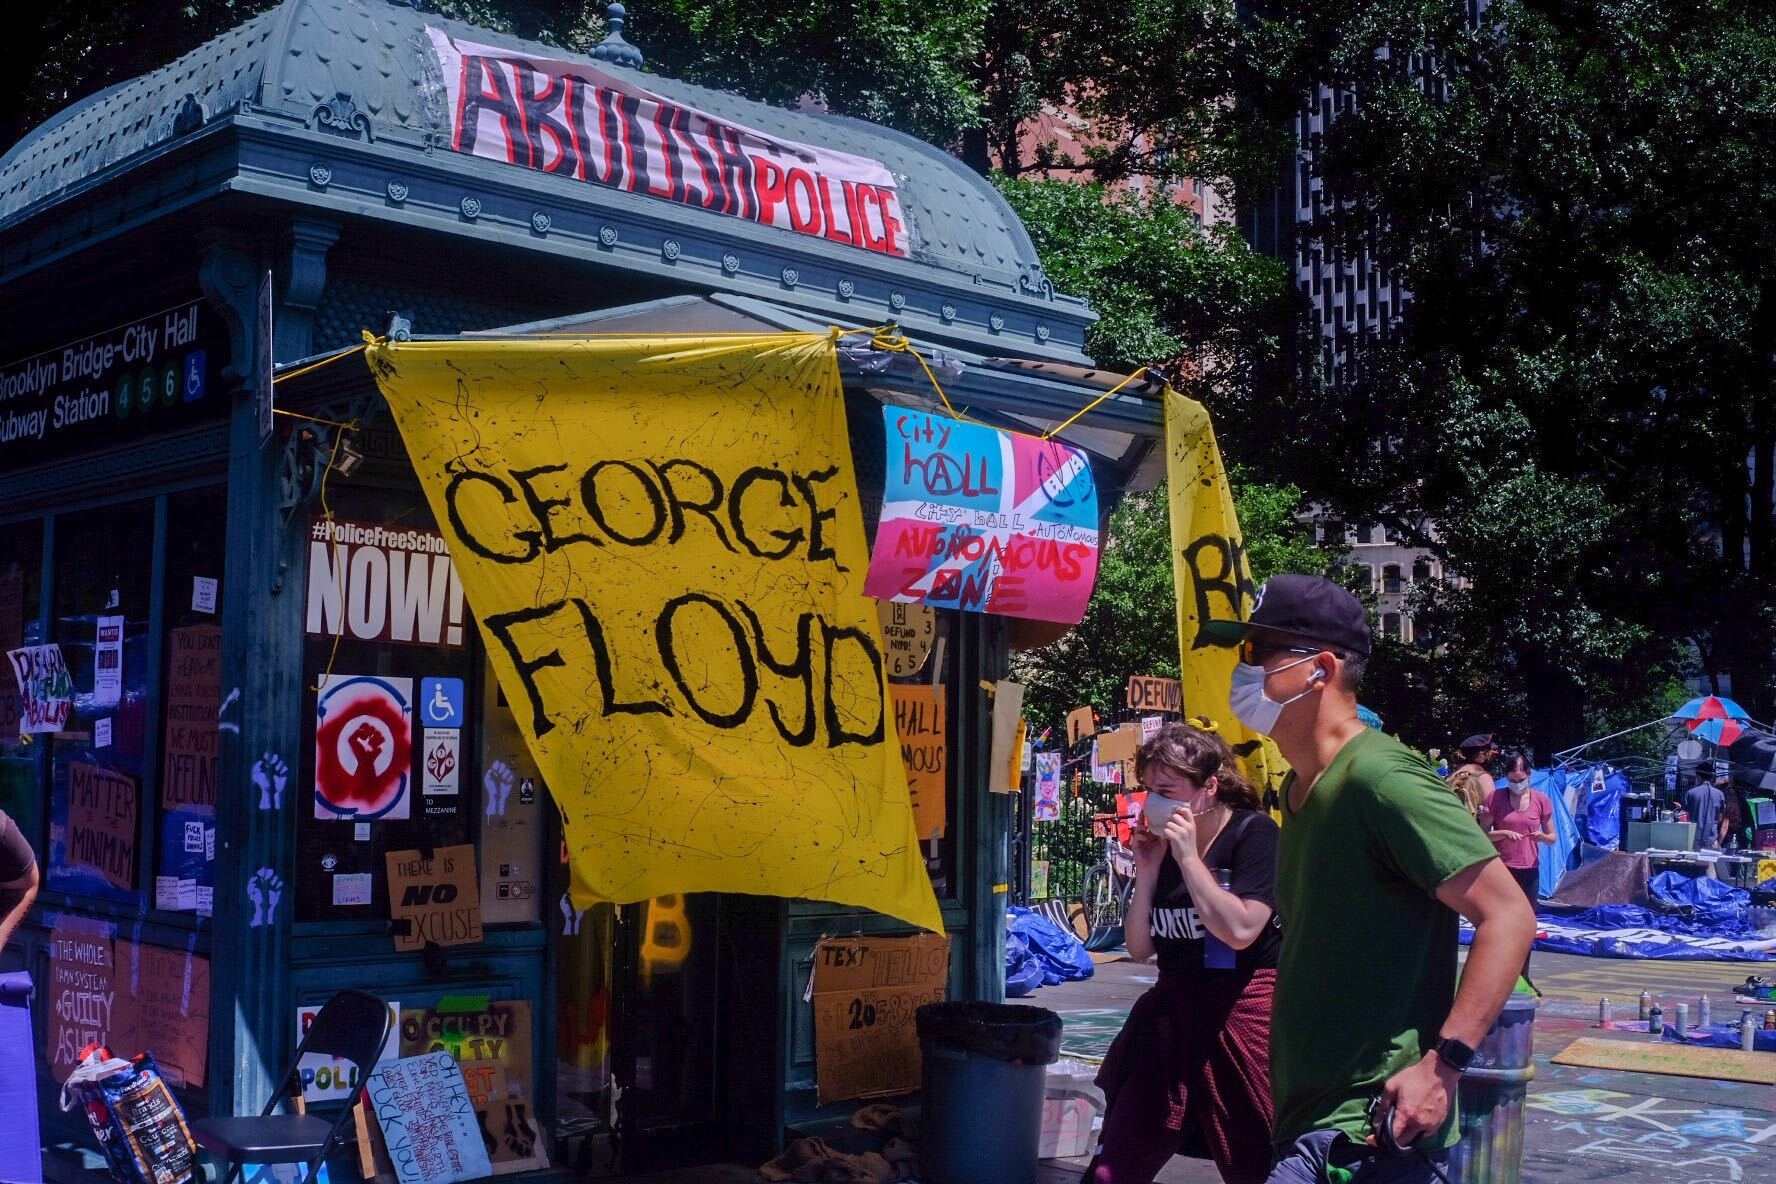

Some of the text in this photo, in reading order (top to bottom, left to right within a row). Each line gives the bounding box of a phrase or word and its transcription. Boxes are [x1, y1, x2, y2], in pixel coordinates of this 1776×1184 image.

[752, 154, 908, 257] POLICE
[164, 305, 198, 349] Hall
[53, 389, 109, 429] Station
[444, 458, 850, 573] GEORGE
[307, 541, 464, 645] NOW!
[884, 625, 916, 638] DEFUND
[920, 641, 927, 653] 4
[924, 621, 932, 634] 3
[485, 592, 886, 749] FLOYD
[894, 657, 902, 673] 6
[908, 655, 916, 669] 5
[1130, 678, 1183, 709] DEFUND
[71, 768, 134, 821] MATTER
[71, 826, 132, 882] MINIMUM
[397, 857, 455, 876] THERE IS
[401, 883, 458, 907] NO
[1151, 907, 1206, 939] UNTIE
[57, 940, 105, 965] THE WHOLE
[822, 946, 945, 987] TEXT HELLO
[74, 969, 109, 991] SYSTEM
[62, 990, 115, 1033] GUILTY
[55, 1025, 74, 1065] AS
[438, 1053, 458, 1078] OH
[368, 1073, 421, 1183] FUCK YOU!
